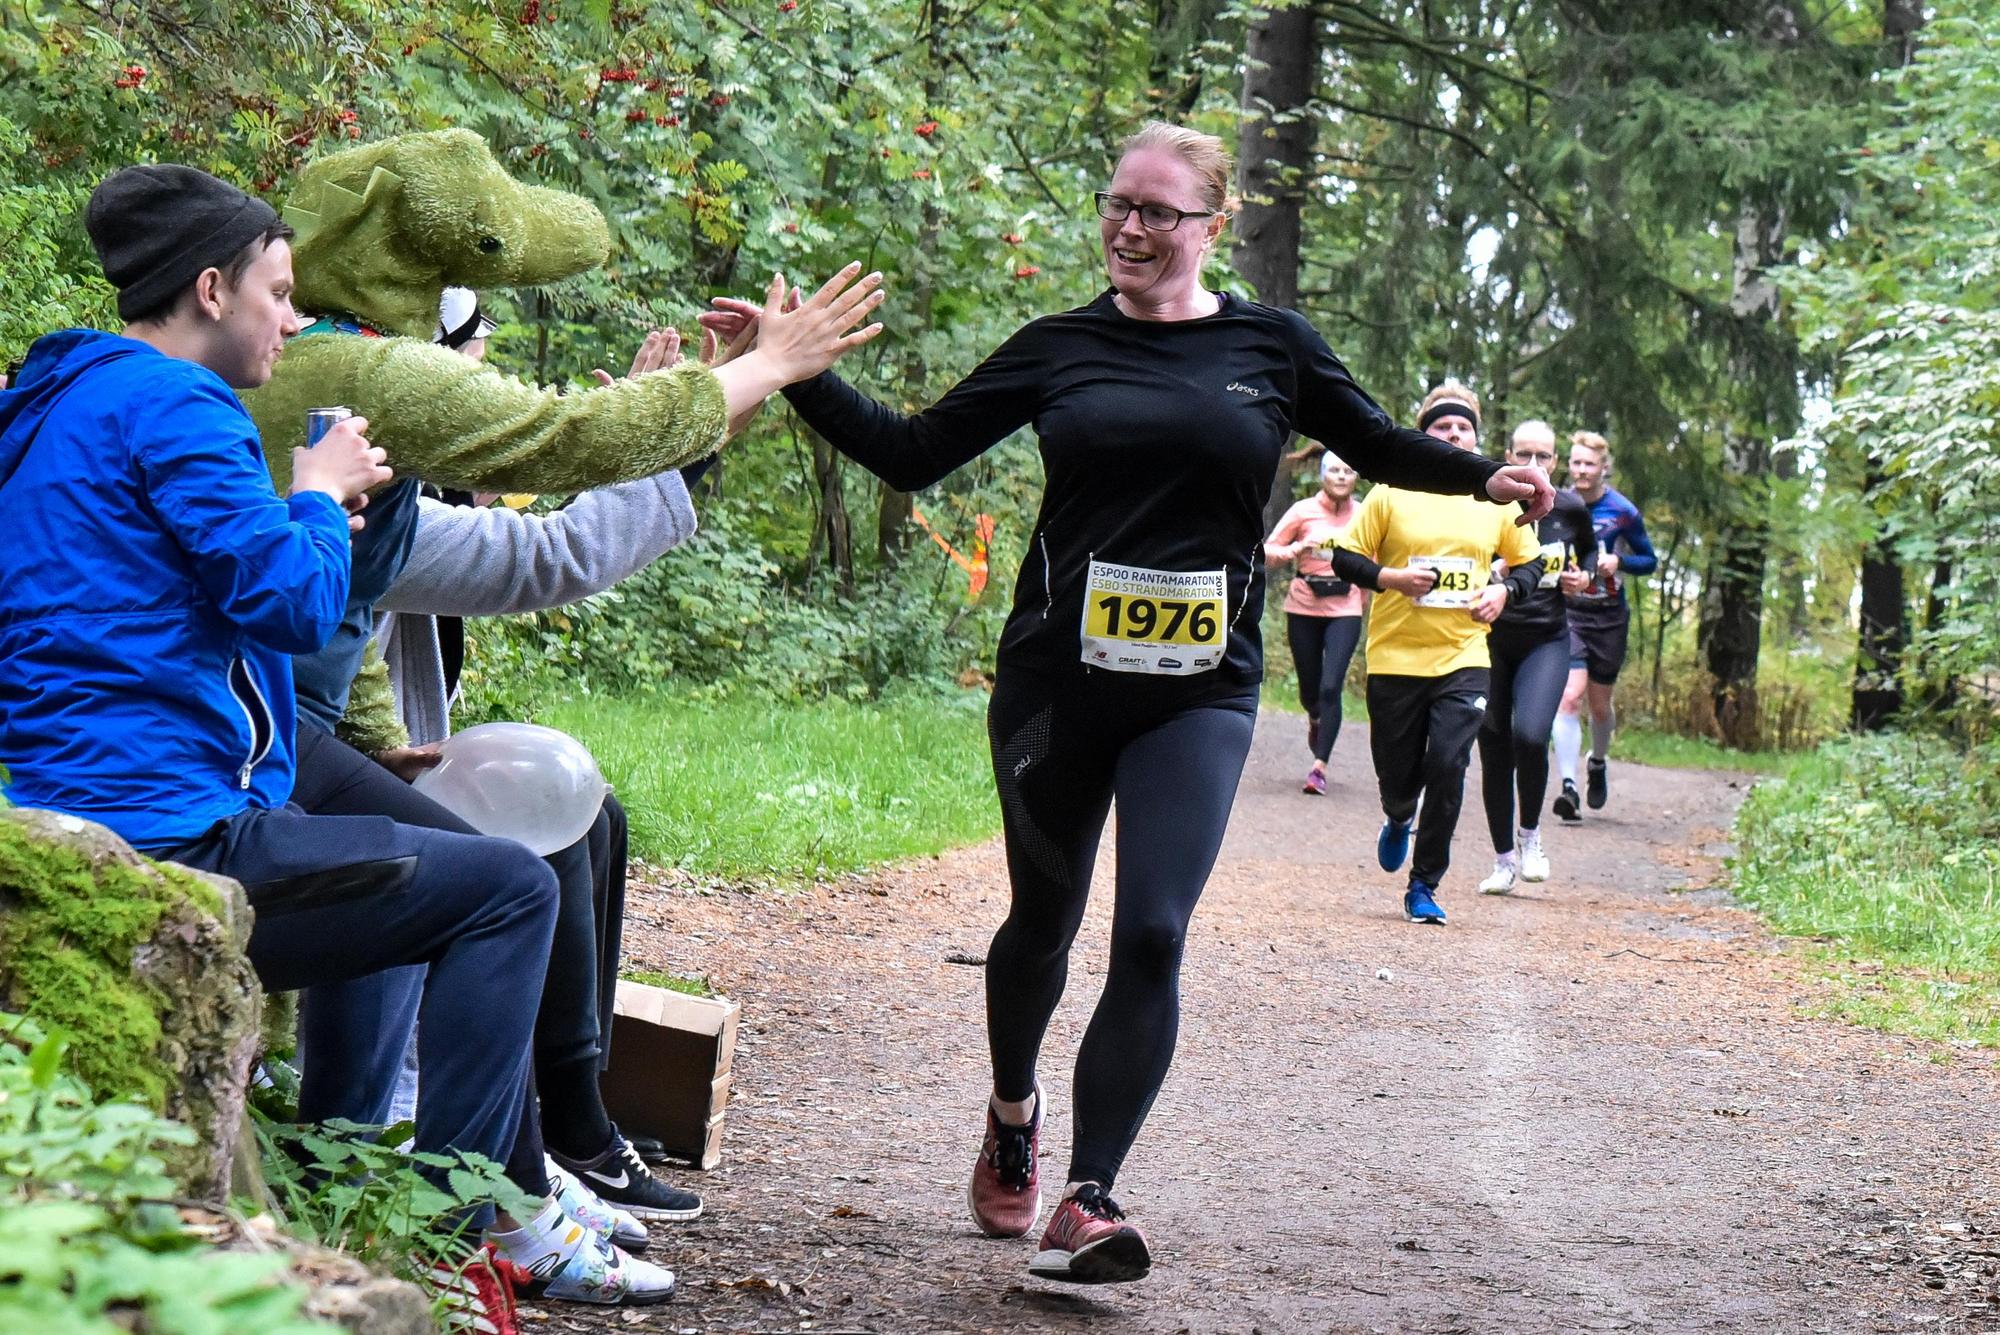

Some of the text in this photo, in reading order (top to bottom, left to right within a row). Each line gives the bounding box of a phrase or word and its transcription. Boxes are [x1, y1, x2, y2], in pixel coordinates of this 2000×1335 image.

[1093, 566, 1215, 586] ESPOO RANTAMARATON
[1091, 578, 1215, 598] ESBO STRANDMARATON
[1098, 595, 1217, 643] 1976
